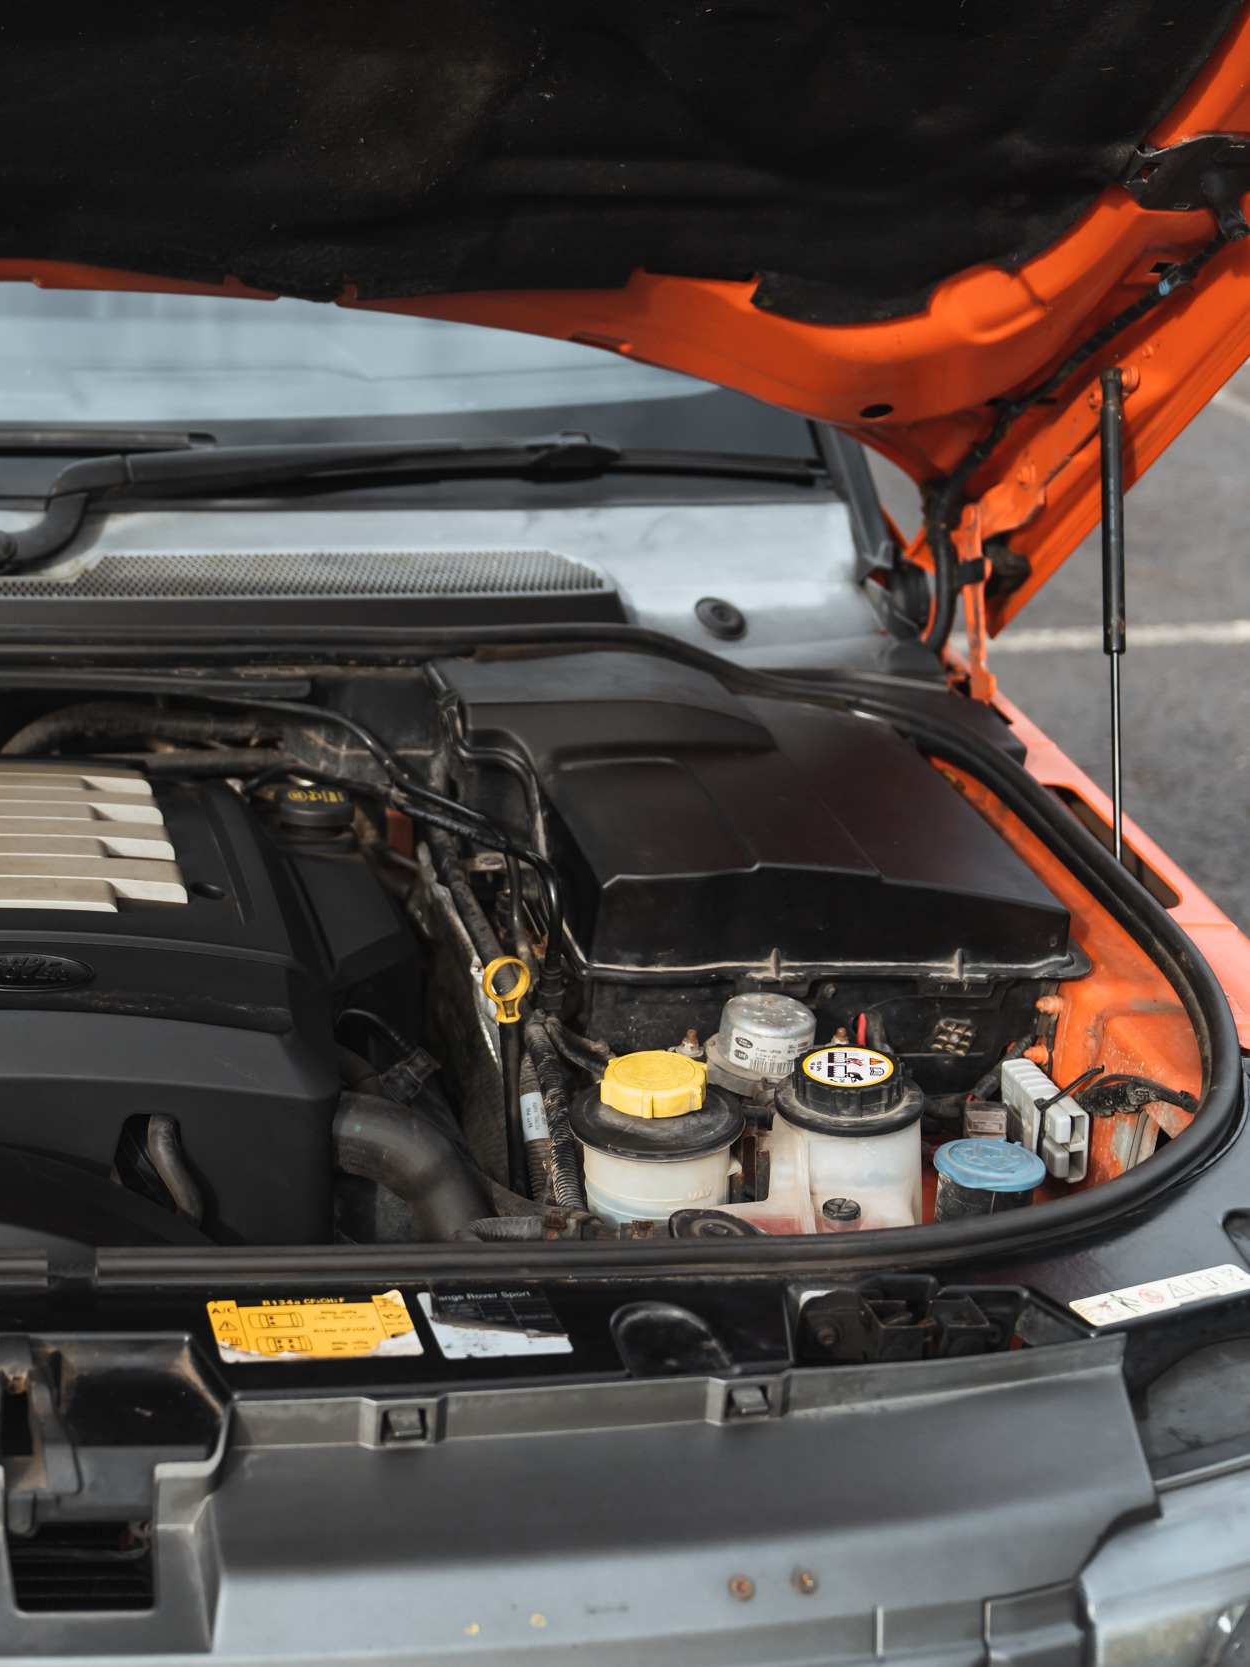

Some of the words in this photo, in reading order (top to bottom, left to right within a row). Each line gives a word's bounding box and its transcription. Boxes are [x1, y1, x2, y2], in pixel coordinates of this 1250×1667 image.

[687, 1187, 712, 1202] MAX
[438, 1294, 464, 1302] ange
[466, 1292, 499, 1300] Rover
[500, 1290, 532, 1299] Sport
[212, 1306, 236, 1314] A/C
